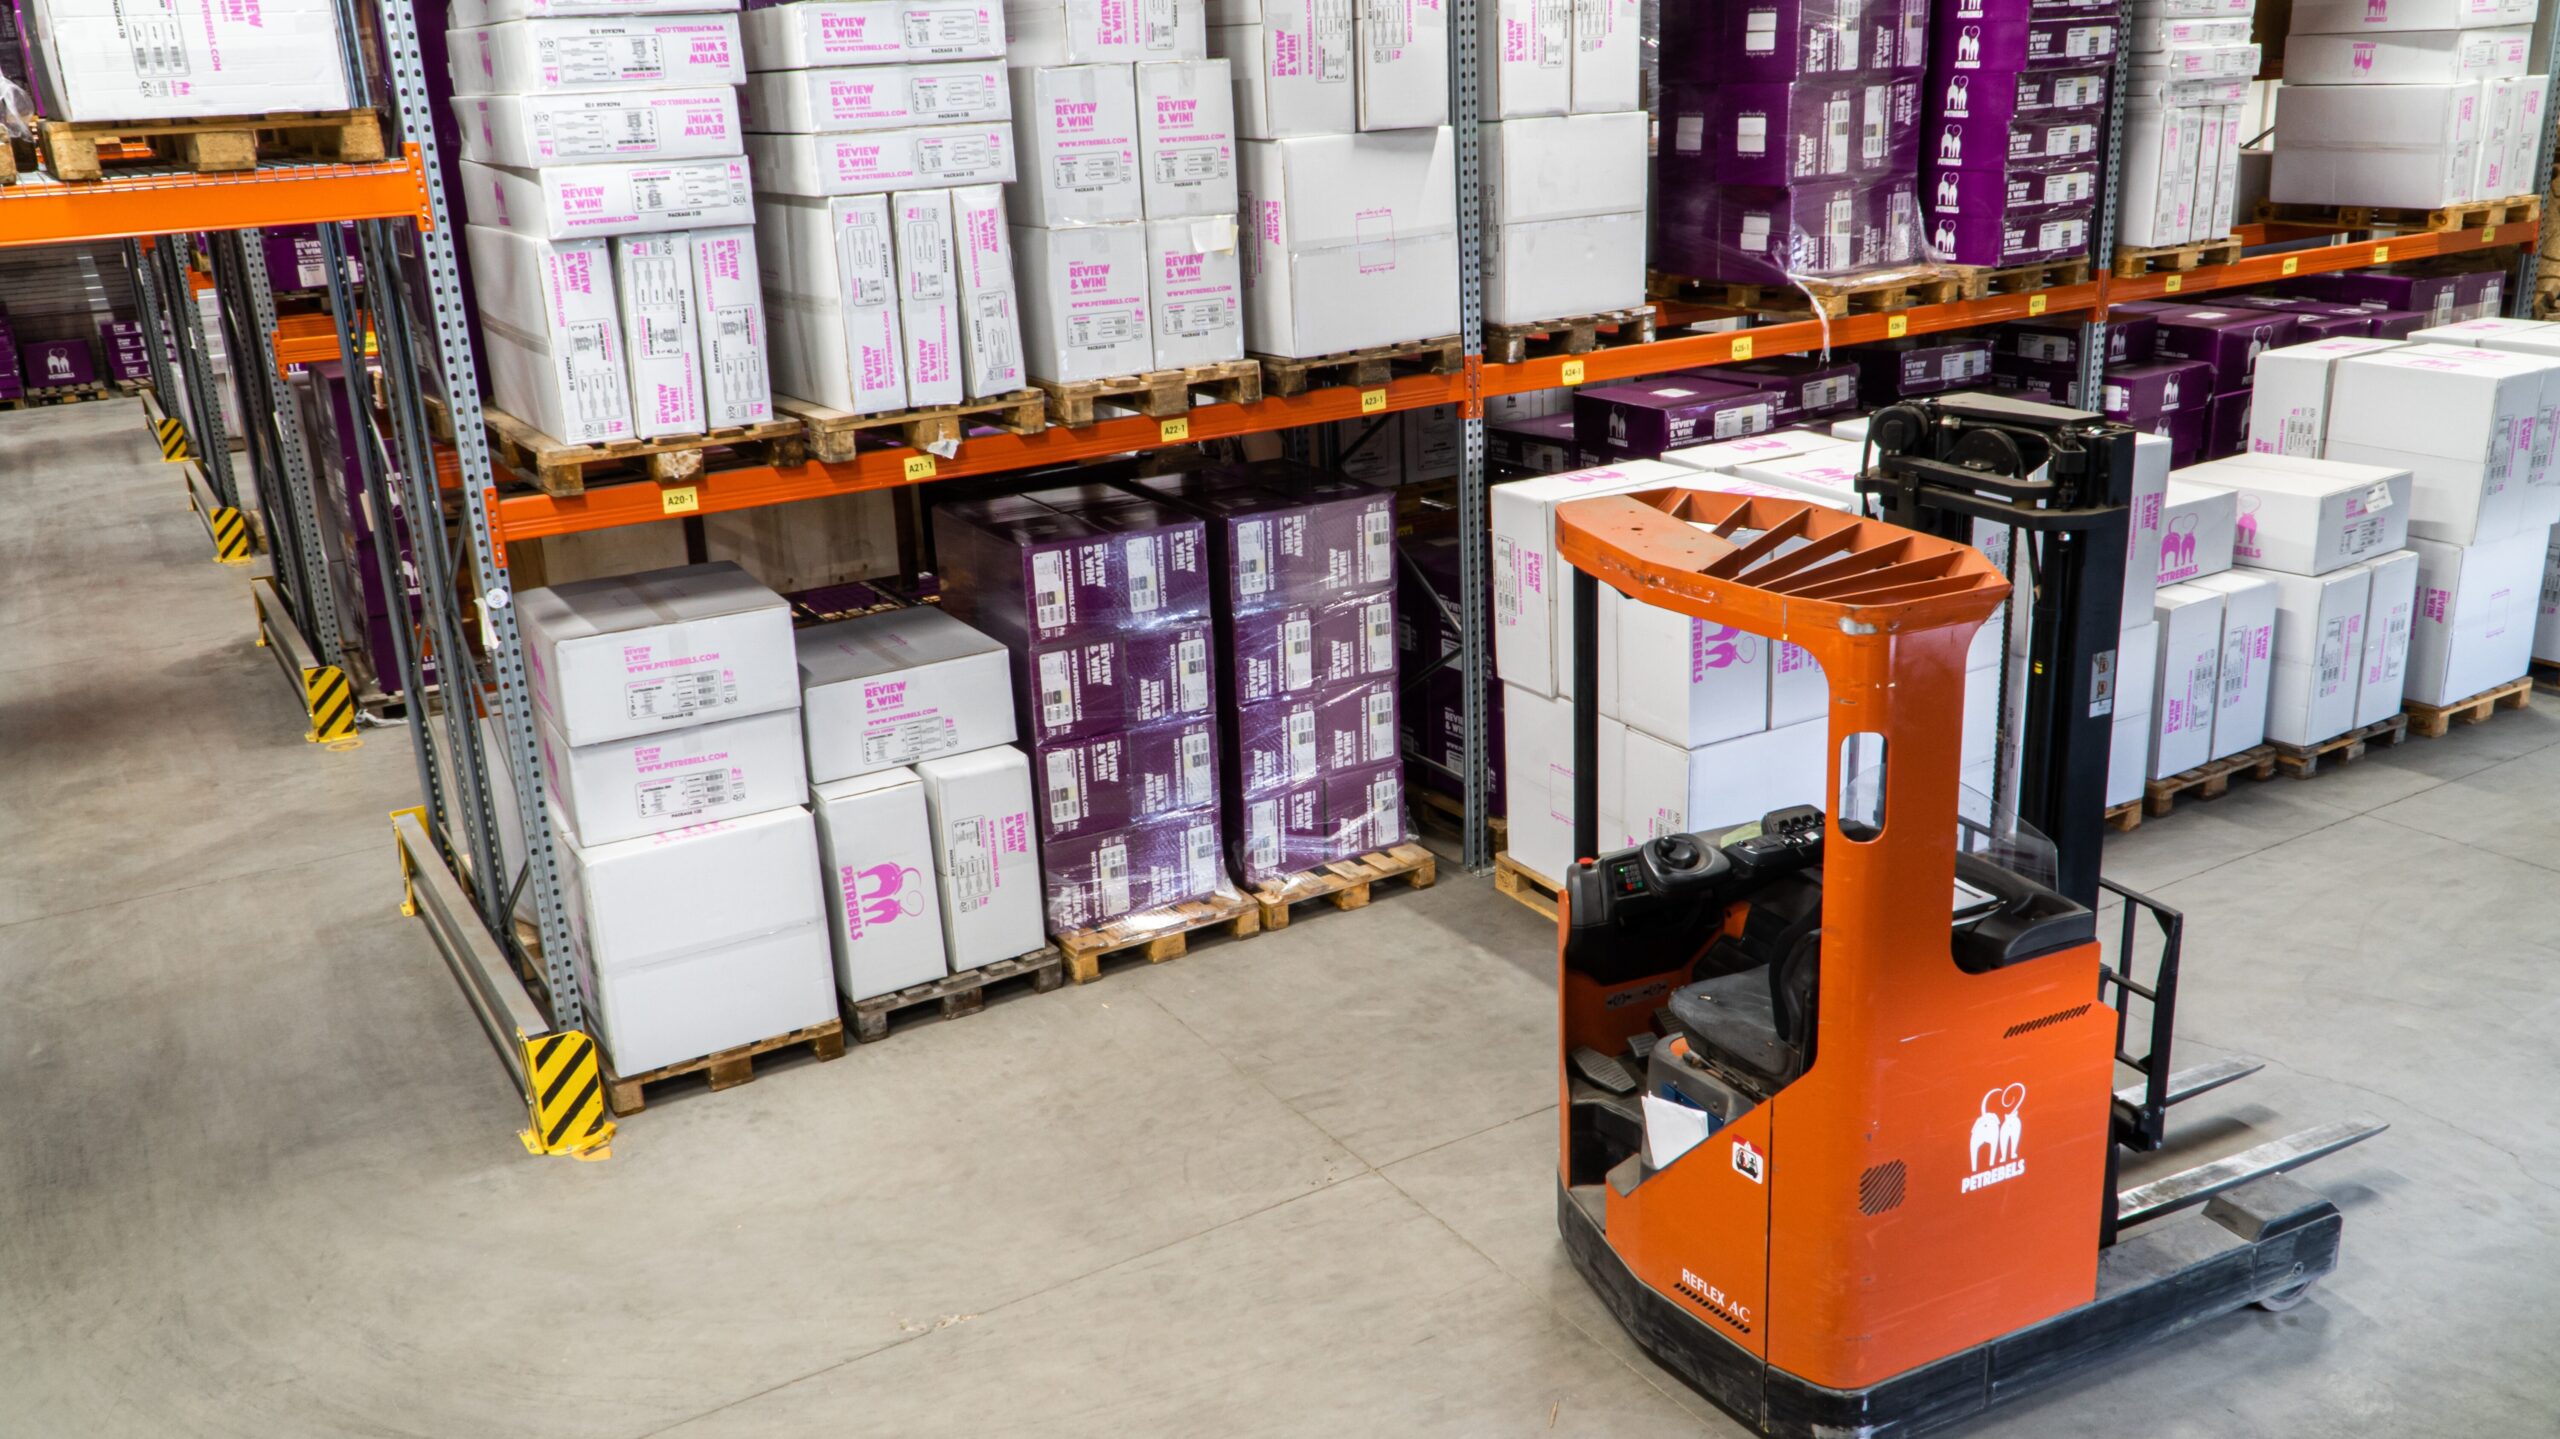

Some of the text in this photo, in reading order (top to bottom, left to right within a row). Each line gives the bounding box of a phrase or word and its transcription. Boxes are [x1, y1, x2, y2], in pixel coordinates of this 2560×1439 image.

[228, 0, 245, 22] IN!
[247, 0, 263, 28] IEW
[821, 17, 866, 28] REVIEW
[201, 0, 221, 72] PETREBELS.COM
[823, 28, 863, 39] & WIN!
[825, 43, 900, 53] WWW.PETREBELS.COM
[2030, 33, 2052, 42] REVIEW
[689, 52, 730, 64] REVIEW
[1276, 29, 1287, 77] REVIEW
[1286, 34, 1297, 76] & WIN!
[830, 84, 874, 96] REVIEW
[832, 95, 871, 106] & WIN!
[1157, 99, 1197, 112] REVIEW
[833, 109, 908, 119] WWW.PETREBELS.COM
[1055, 102, 1097, 115] REVIEW
[1056, 115, 1094, 128] & WIN!
[1158, 112, 1193, 124] & WIN!
[836, 146, 880, 158] REVIEW
[1057, 136, 1128, 148] WWW.PETREBELS.COM
[1158, 133, 1226, 144] WWW.PETREBELS.COM
[2009, 133, 2032, 142] REVIEW
[838, 157, 877, 168] & WIN!
[840, 171, 913, 182] WWW.PETREBELS.COM
[561, 186, 605, 199] REVIEW
[567, 215, 639, 226] WWW.PETREBELS.COM
[978, 209, 990, 250] & WIN!
[986, 208, 999, 253] REVIEW
[718, 240, 729, 277] & WIN!
[726, 239, 740, 280] REVIEW
[967, 211, 982, 288] WWW.PETREBELS.COM
[1165, 254, 1204, 267] REVIEW
[566, 253, 581, 291] & WIN!
[576, 252, 591, 294] REVIEW
[700, 243, 714, 312] WWW.PETREBELS.COM
[1069, 264, 1110, 277] REVIEW
[1070, 277, 1107, 289] & WIN!
[1166, 265, 1201, 279] & WIN!
[549, 256, 566, 327] WWW.PETREBELS.COM
[1071, 297, 1140, 309] WWW.PETREBELS.COM
[1166, 285, 1232, 297] WWW.PETREBELS.COM
[883, 310, 896, 387] WWW.PETREBELS.COM
[939, 304, 950, 380] WWW.PETREBELS.COM
[1734, 343, 1750, 355] A25-1
[862, 345, 875, 390] REVIEW
[871, 349, 884, 389] & WIN!
[918, 338, 929, 384] REVIEW
[928, 343, 938, 382] & WIN!
[1565, 368, 1581, 379] A24-1
[1905, 360, 1927, 370] REVIEW
[658, 384, 671, 424] REVIEW
[683, 353, 695, 420] WWW.PETREBELS.COM
[1364, 396, 1383, 406] A23-1
[669, 387, 680, 423] & WIN!
[1165, 424, 1185, 436] A22-1
[1670, 419, 1697, 430] REVIEW
[1677, 427, 1693, 437] WIN!
[909, 461, 933, 473] A21-1
[668, 494, 694, 506] A20-1
[1174, 531, 1186, 570] & WIN!
[1184, 529, 1196, 573] REVIEW
[1283, 516, 1294, 556] & WIN!
[1292, 515, 1303, 557] REVIEW
[1083, 546, 1096, 585] & WIN!
[1094, 544, 1107, 588] REVIEW
[1328, 548, 1339, 589] REVIEW
[1533, 552, 1542, 594] REVIEW
[2157, 563, 2199, 584] PETREBELS
[1065, 549, 1077, 624] WWW.PETREBELS.COM
[2435, 590, 2447, 625] REVIEW
[627, 653, 720, 674] WWW.PETREBELS.COM
[1089, 645, 1102, 684] & WIN!
[1100, 643, 1113, 686] REVIEW
[1331, 640, 1341, 681] REVIEW
[864, 681, 907, 699] REVIEW
[865, 692, 904, 709] & WIN!
[1071, 649, 1083, 722] WWW.PETREBELS.COM
[1140, 678, 1151, 721] REVIEW
[1150, 681, 1161, 718] & WIN!
[867, 707, 938, 727] WWW.PETREBELS.COM
[637, 752, 728, 773] WWW.PETREBELS.COM
[1097, 743, 1108, 780] & WIN!
[1106, 740, 1119, 783] REVIEW
[1334, 729, 1344, 769] REVIEW
[1077, 747, 1089, 818] WWW.PETREBELS.COM
[1144, 772, 1156, 814] REVIEW
[1303, 791, 1313, 830] REVIEW
[1005, 816, 1017, 852] & WIN!
[1014, 812, 1028, 853] REVIEW
[989, 820, 1000, 888] WWW.PETREBELS.COM
[842, 866, 863, 941] PETREBELS
[1961, 1158, 2026, 1194] PETREBELS
[1682, 1268, 1751, 1323] REFLEX AC
